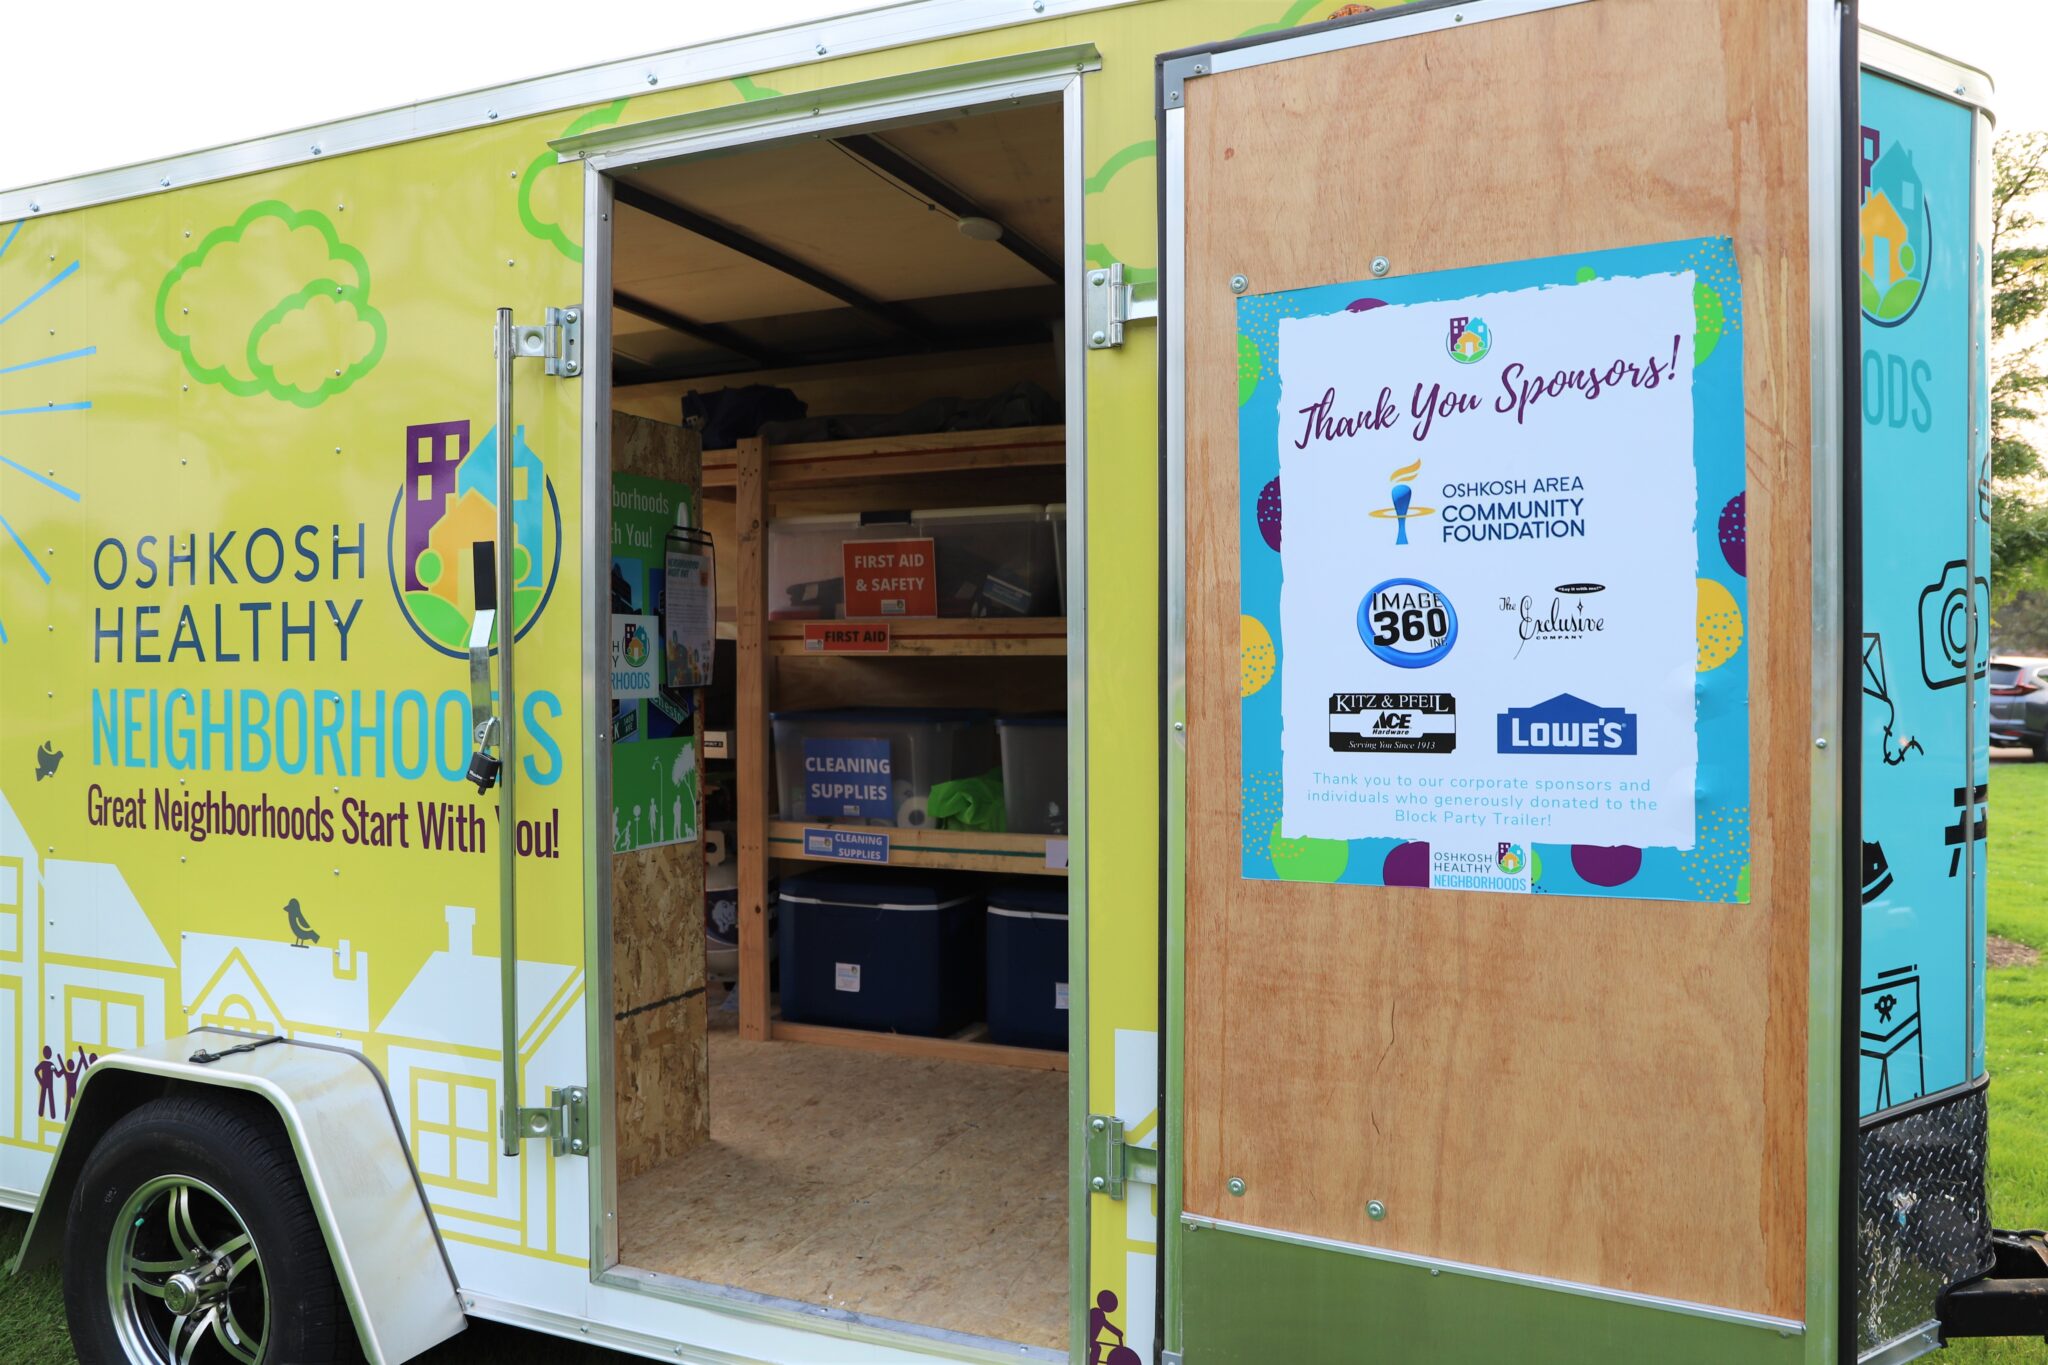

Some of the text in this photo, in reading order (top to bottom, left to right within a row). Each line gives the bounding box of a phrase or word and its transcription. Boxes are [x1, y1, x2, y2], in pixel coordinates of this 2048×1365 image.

[1294, 334, 1681, 449] Thank You Sponsors!
[1442, 476, 1584, 499] OSHKOSH AREA
[1442, 498, 1584, 523] COMMUNITY
[626, 523, 652, 548] You!
[1442, 519, 1585, 543] FOUNDATION
[94, 523, 366, 590] OSHKOSH
[854, 554, 924, 568] FIRST AID
[855, 577, 925, 592] & SAFETY
[1372, 593, 1443, 611] IMAGE
[94, 599, 364, 663] HEALTHY
[824, 630, 886, 643] FIRST AID
[1373, 608, 1447, 647] 360
[1499, 595, 1604, 660] The Exclusive
[1335, 694, 1449, 713] KITZ & PFEIL
[1372, 711, 1412, 729] ACE
[92, 688, 563, 787] NEIGHBORHOOS
[1512, 716, 1622, 748] LOWE'S
[1348, 740, 1436, 750] Serving You Since 1913
[805, 756, 890, 774] CLEANING
[1312, 772, 1651, 792] Thank you to our corporate sponsors and
[811, 783, 888, 801] SUPPLIES
[1307, 789, 1657, 811] individuals who generously donated to the
[88, 784, 560, 859] Great Neighborhoods Start With ou!
[1395, 809, 1552, 827] Block Party Trailer!
[835, 833, 882, 845] CLEANING
[838, 848, 881, 860] SUPPLIES
[1434, 852, 1493, 863] OSHKOSH
[1434, 862, 1492, 874] HEALTHY
[1434, 874, 1527, 891] NEIGHBORHOODS
